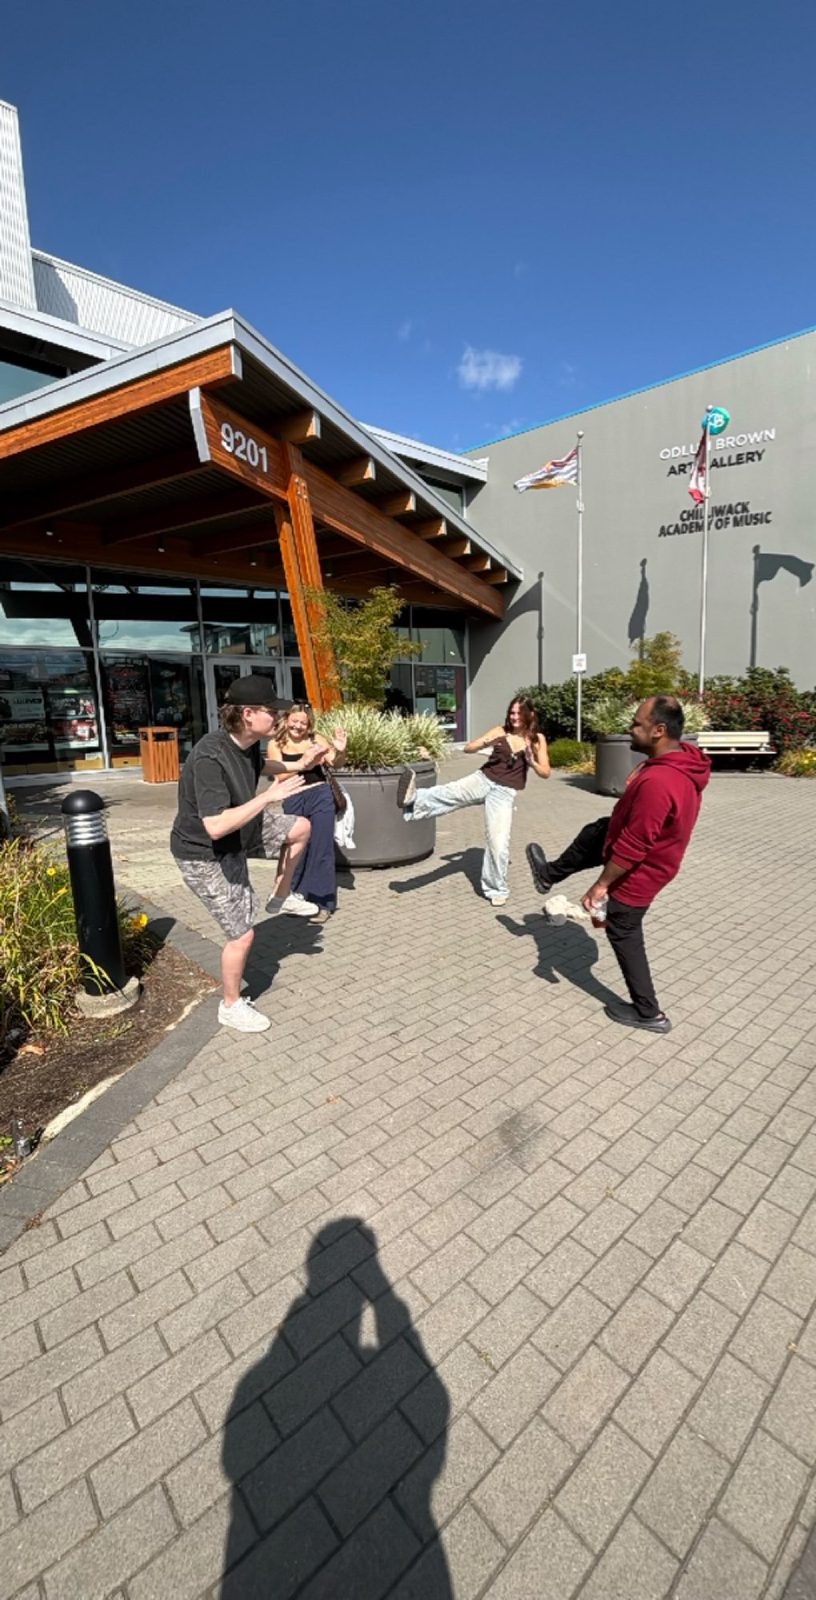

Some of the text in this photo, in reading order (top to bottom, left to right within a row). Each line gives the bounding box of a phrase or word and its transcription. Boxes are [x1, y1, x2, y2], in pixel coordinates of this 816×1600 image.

[221, 423, 268, 473] 9201
[715, 428, 776, 450] BROWN
[703, 449, 766, 470] ALLERY
[715, 516, 731, 530] OF
[732, 511, 772, 528] MUSIC
